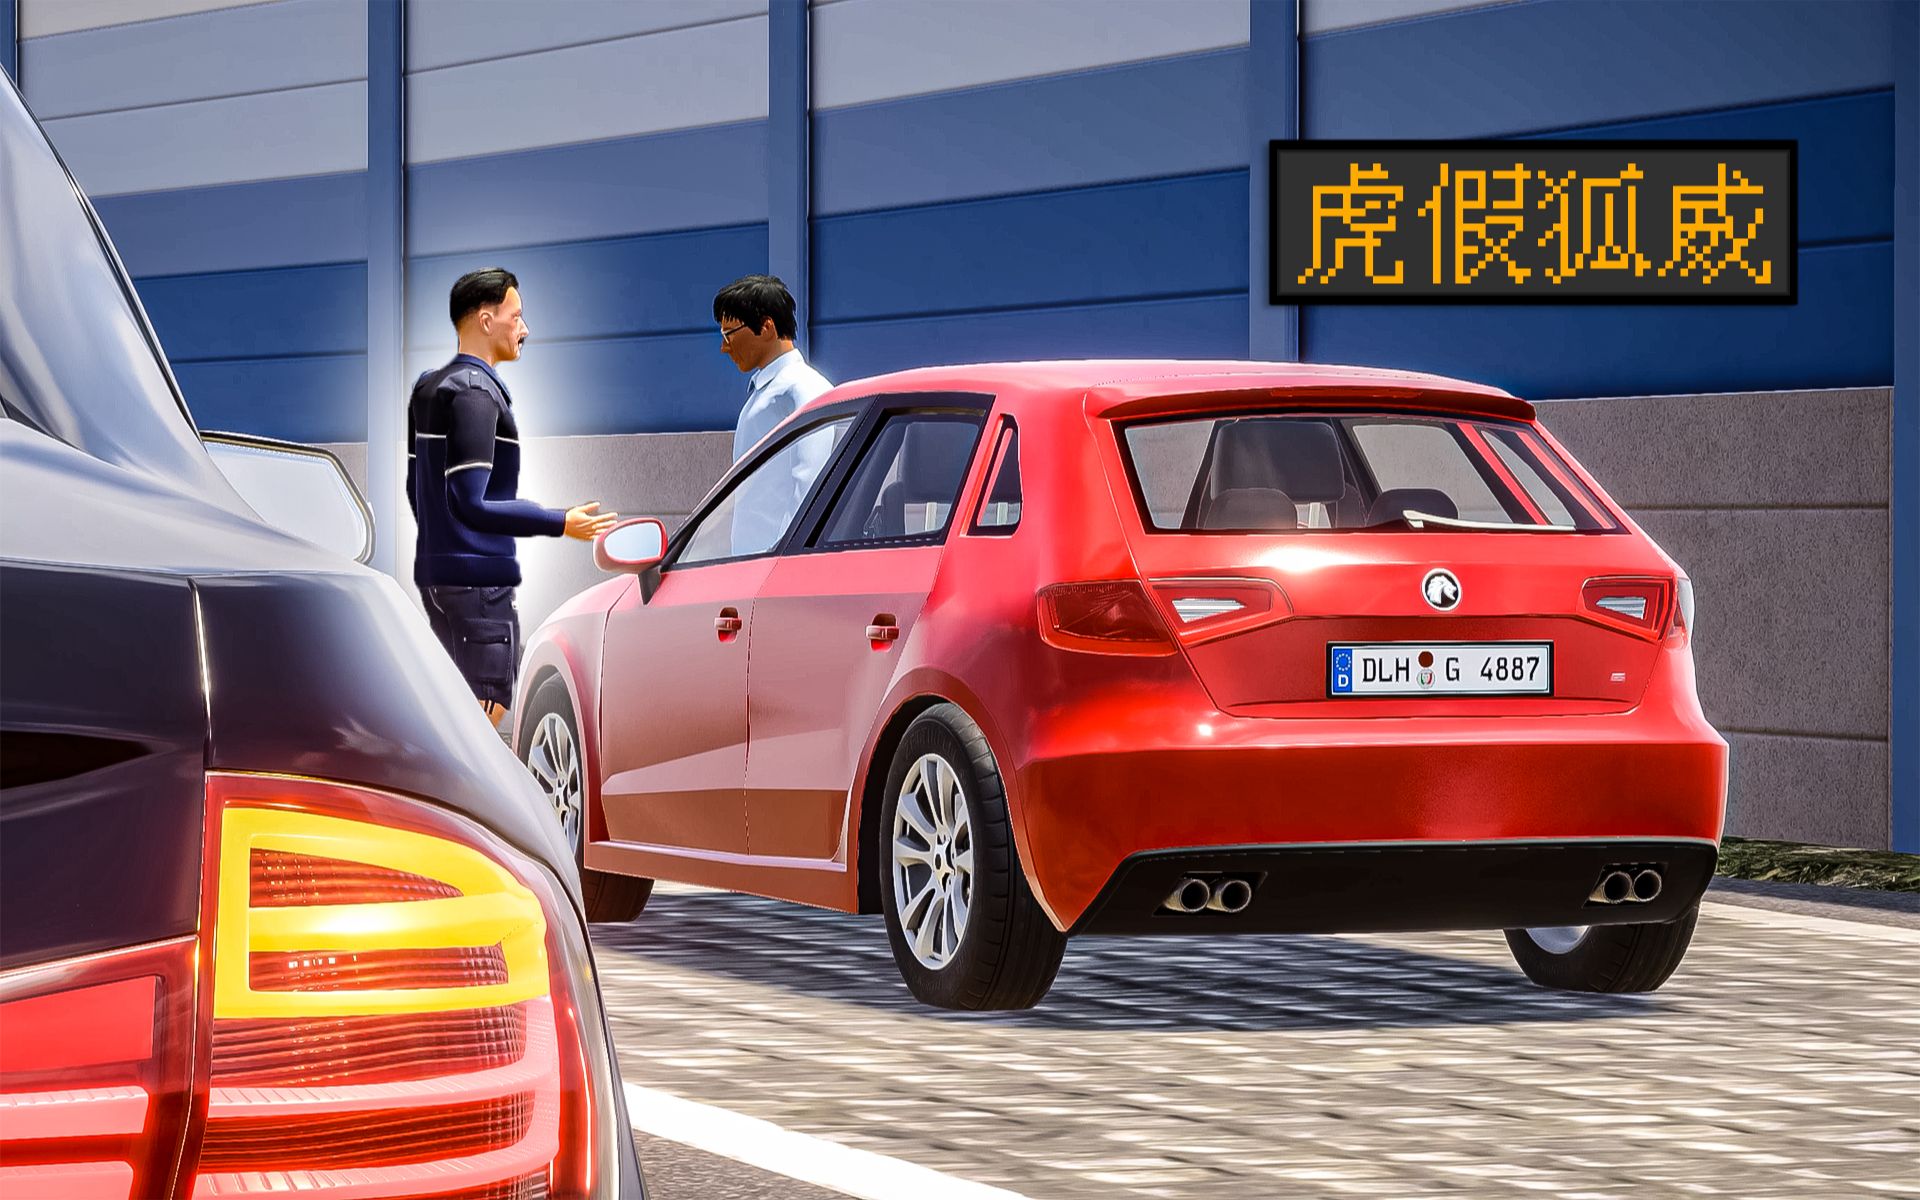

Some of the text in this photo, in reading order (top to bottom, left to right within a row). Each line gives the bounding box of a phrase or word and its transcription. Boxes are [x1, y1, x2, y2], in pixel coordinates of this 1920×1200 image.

[1297, 163, 1771, 284] 虎假狐威
[1337, 674, 1349, 687] D
[1362, 657, 1540, 682] DLH G 4887
